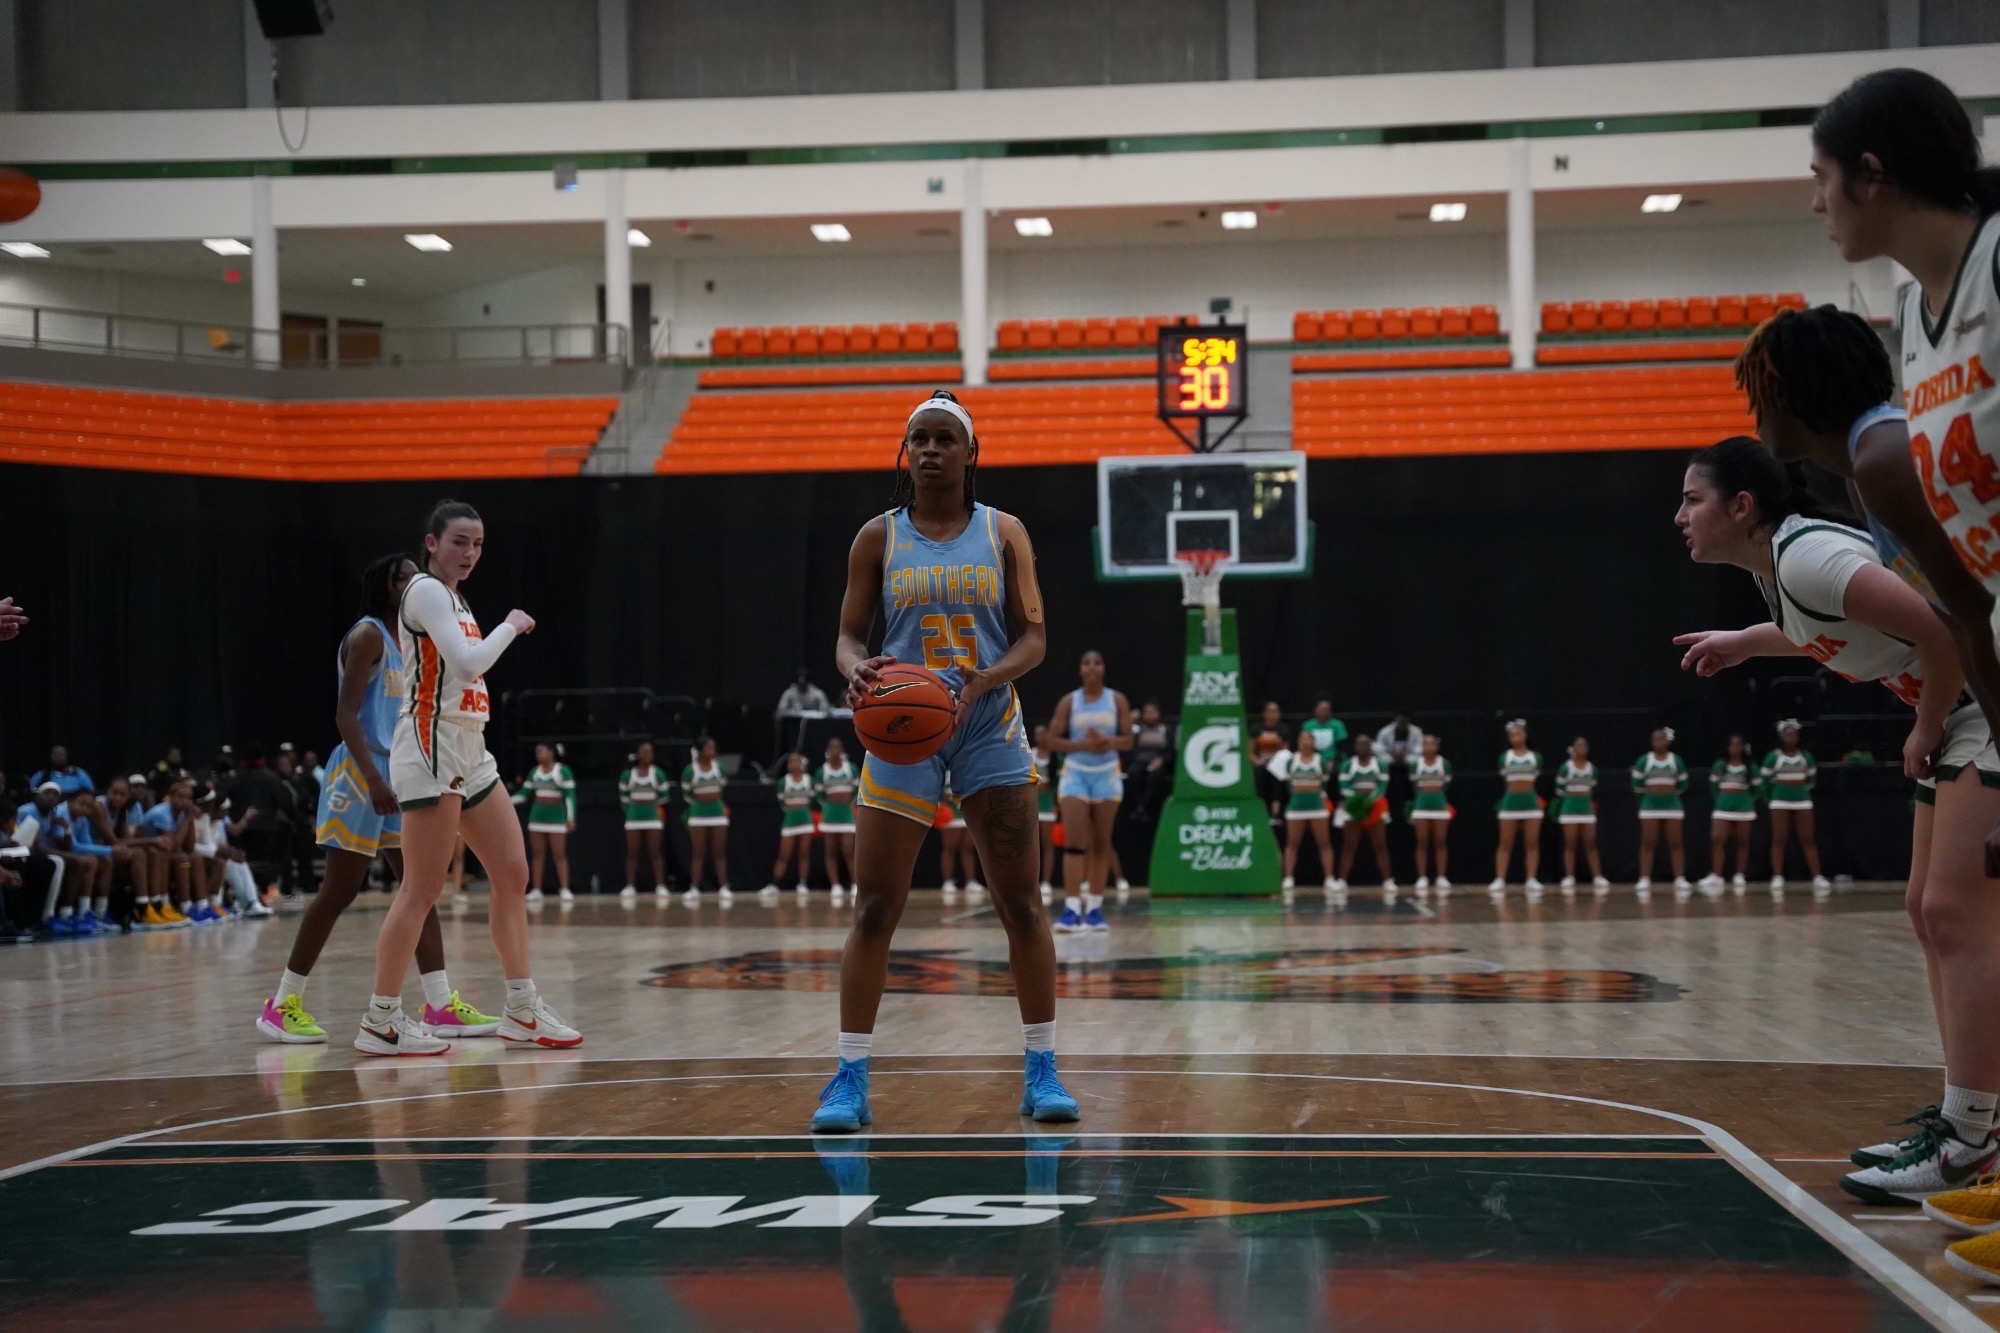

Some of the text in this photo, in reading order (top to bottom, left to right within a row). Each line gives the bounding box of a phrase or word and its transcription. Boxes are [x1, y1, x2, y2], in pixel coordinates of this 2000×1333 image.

[1554, 154, 1569, 172] N
[1183, 338, 1236, 366] 5:34
[1179, 366, 1229, 411] 30
[1910, 412, 2000, 524] 24
[891, 565, 998, 609] SOUTHERN
[920, 613, 978, 670] 25
[1184, 725, 1241, 788] G
[1179, 824, 1253, 844] DREAM
[1192, 845, 1252, 870] Black
[129, 1194, 1098, 1235] SWAC
